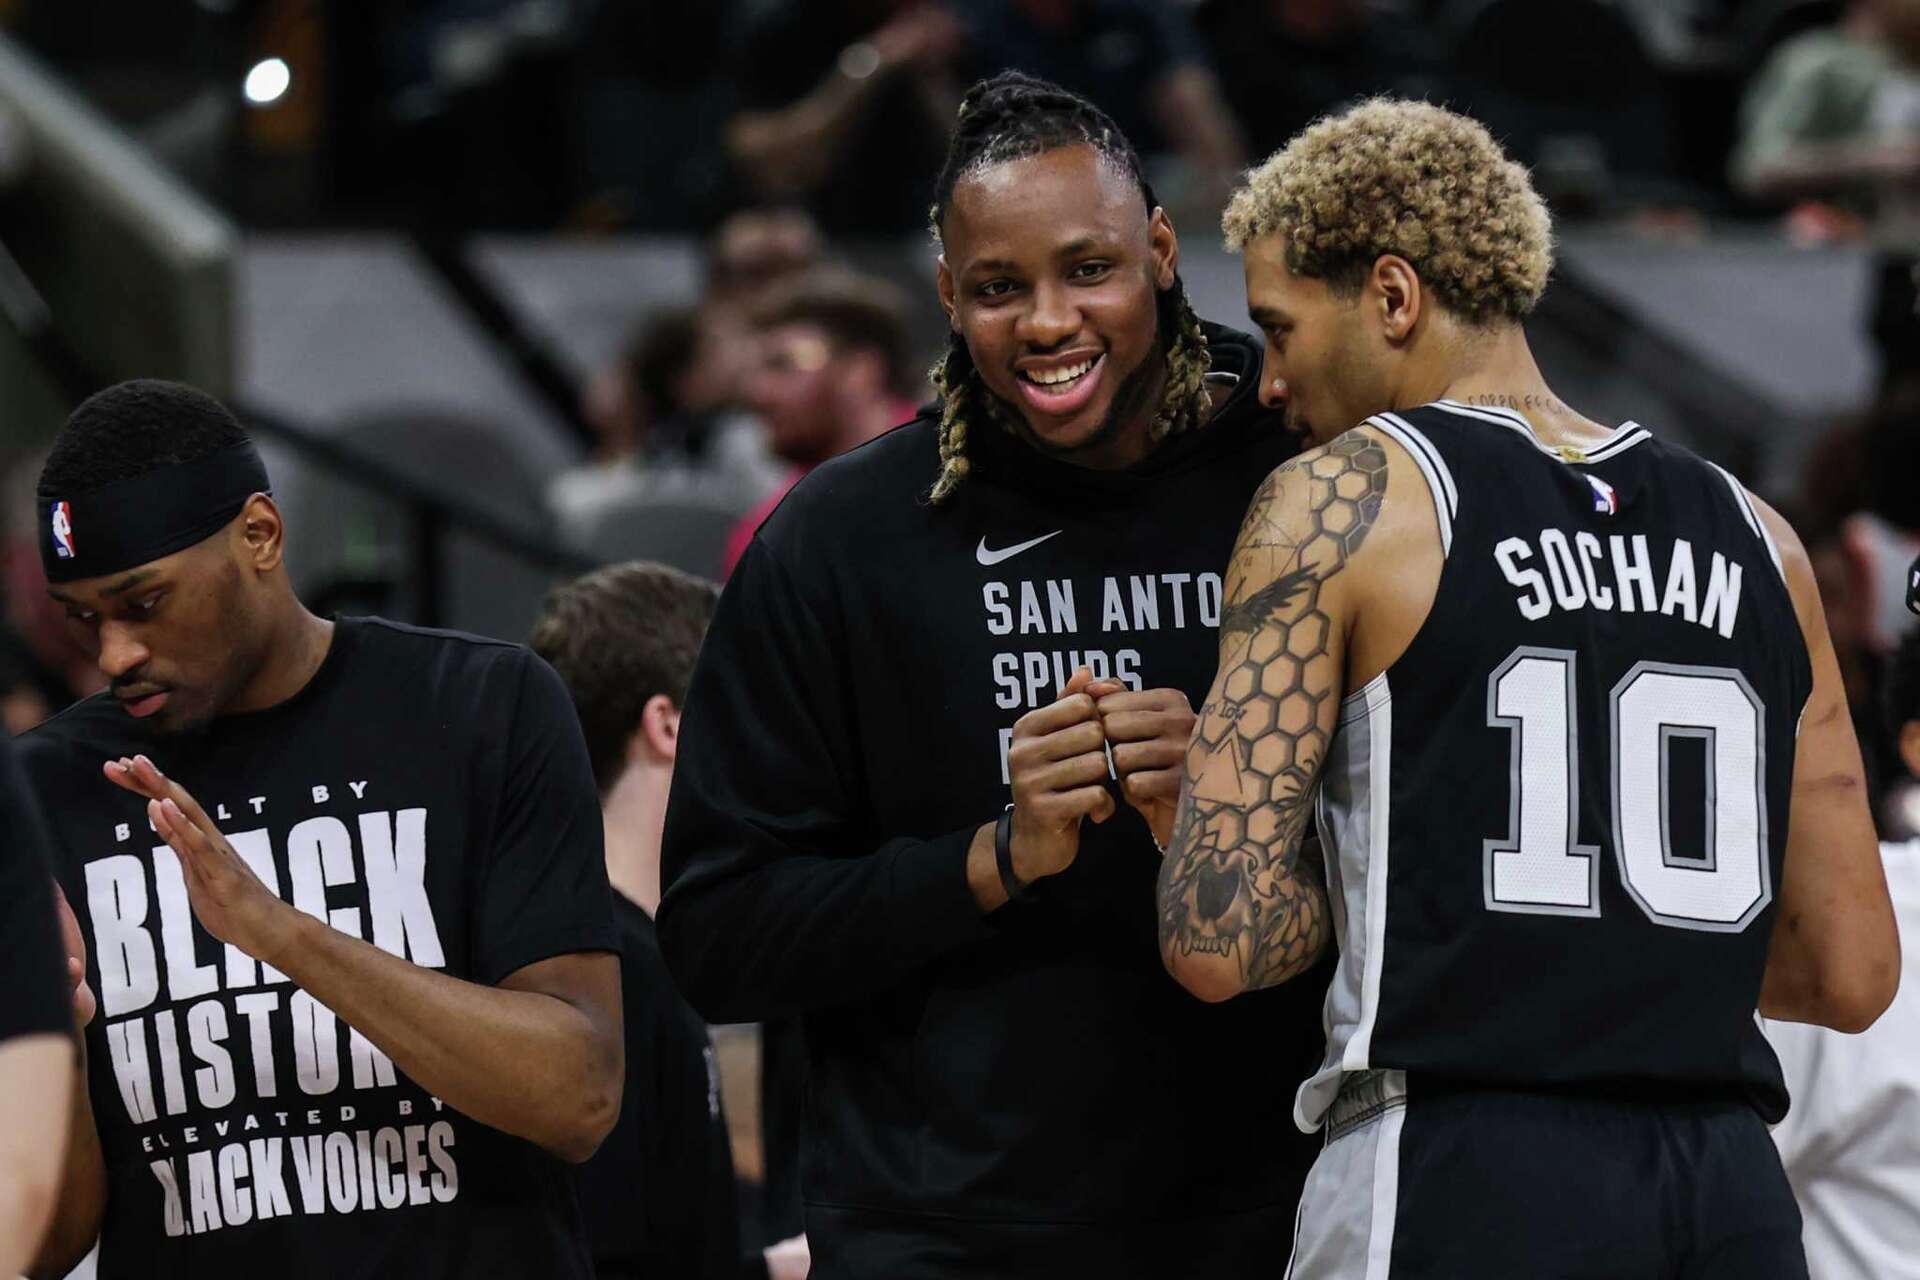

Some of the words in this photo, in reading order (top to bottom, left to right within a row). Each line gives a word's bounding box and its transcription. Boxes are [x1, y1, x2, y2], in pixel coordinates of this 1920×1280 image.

[982, 578, 1077, 636] SAN
[1102, 571, 1222, 632] ANTO
[1494, 528, 1743, 639] SOCHAN
[115, 797, 266, 842] BLT
[311, 780, 369, 803] BY
[1483, 644, 1772, 933] 10
[106, 988, 398, 1124] HISTO
[142, 1105, 356, 1153] ELEVATED
[398, 1096, 443, 1115] BY
[150, 1136, 293, 1237] BACK
[290, 1120, 458, 1214] VOICES
